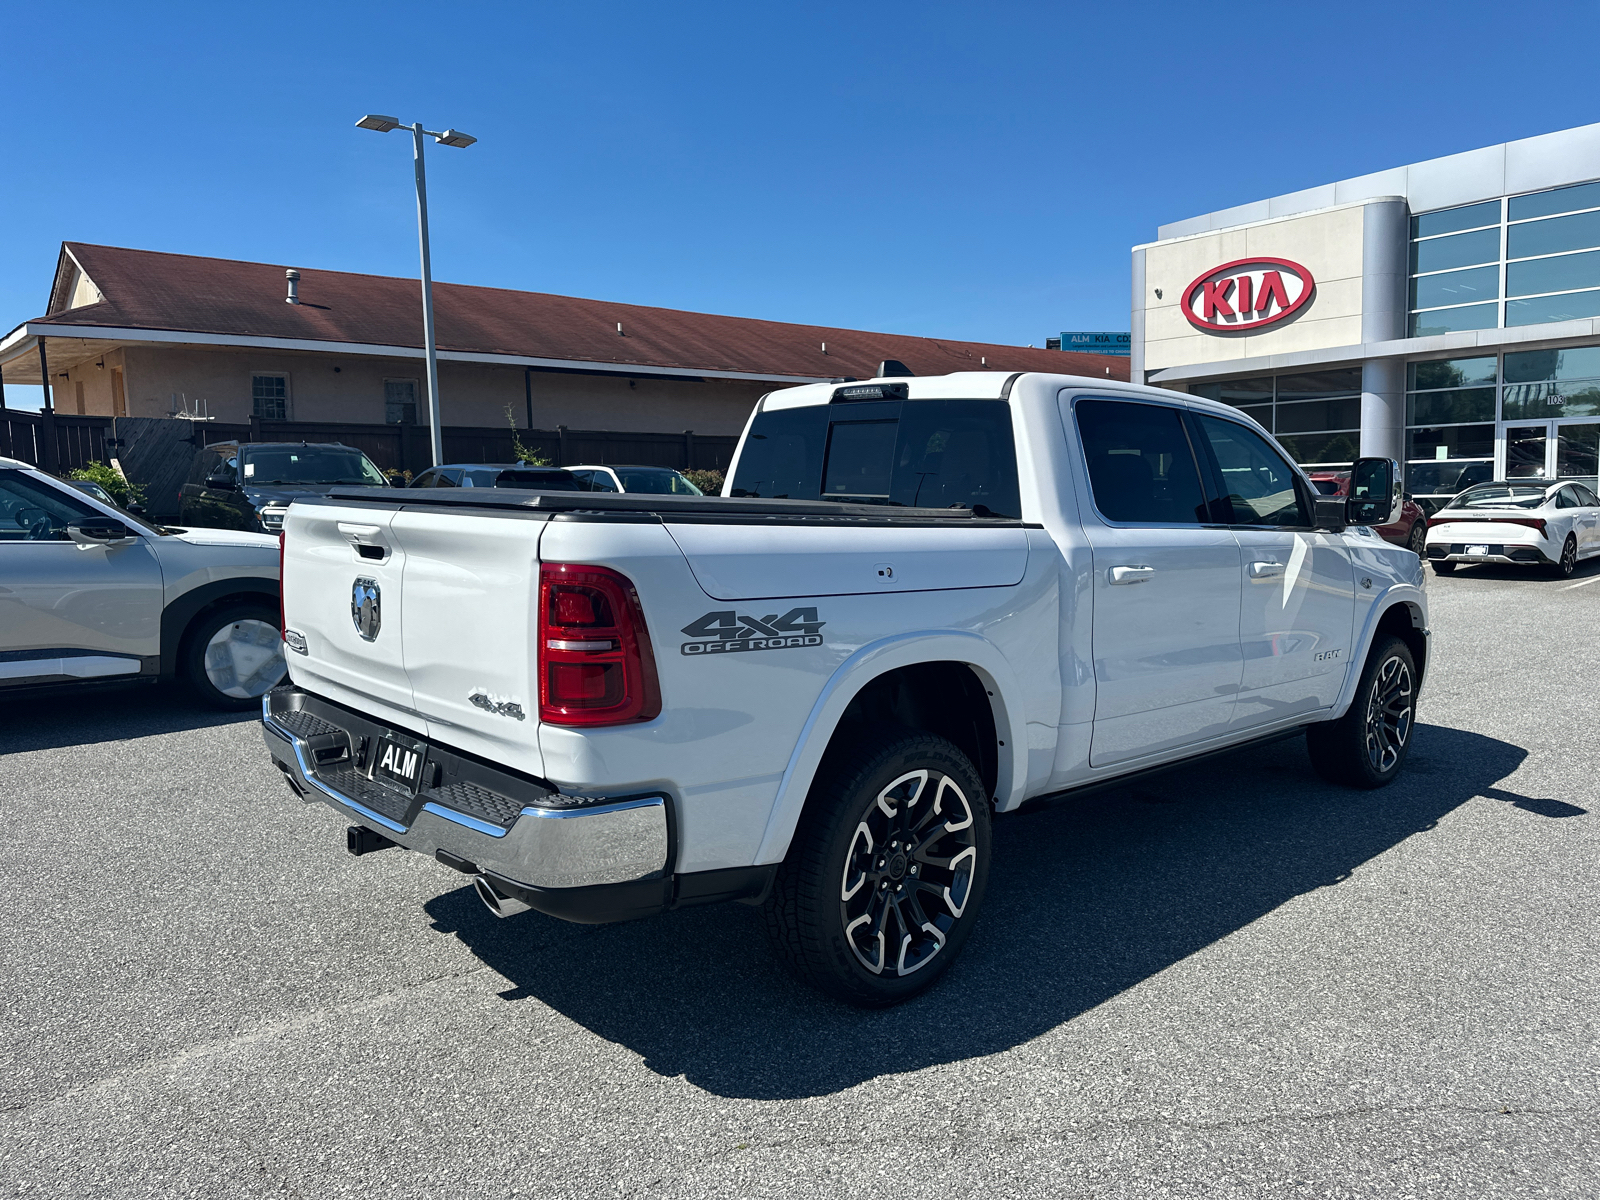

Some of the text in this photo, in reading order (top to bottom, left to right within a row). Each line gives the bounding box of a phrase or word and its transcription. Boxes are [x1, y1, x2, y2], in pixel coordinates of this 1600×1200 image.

[1202, 270, 1291, 318] KIA
[1071, 335, 1090, 343] ALM
[1095, 335, 1110, 343] KIA
[684, 636, 821, 654] OFF ROAD
[1314, 649, 1342, 661] RAM
[380, 743, 418, 780] ALM
